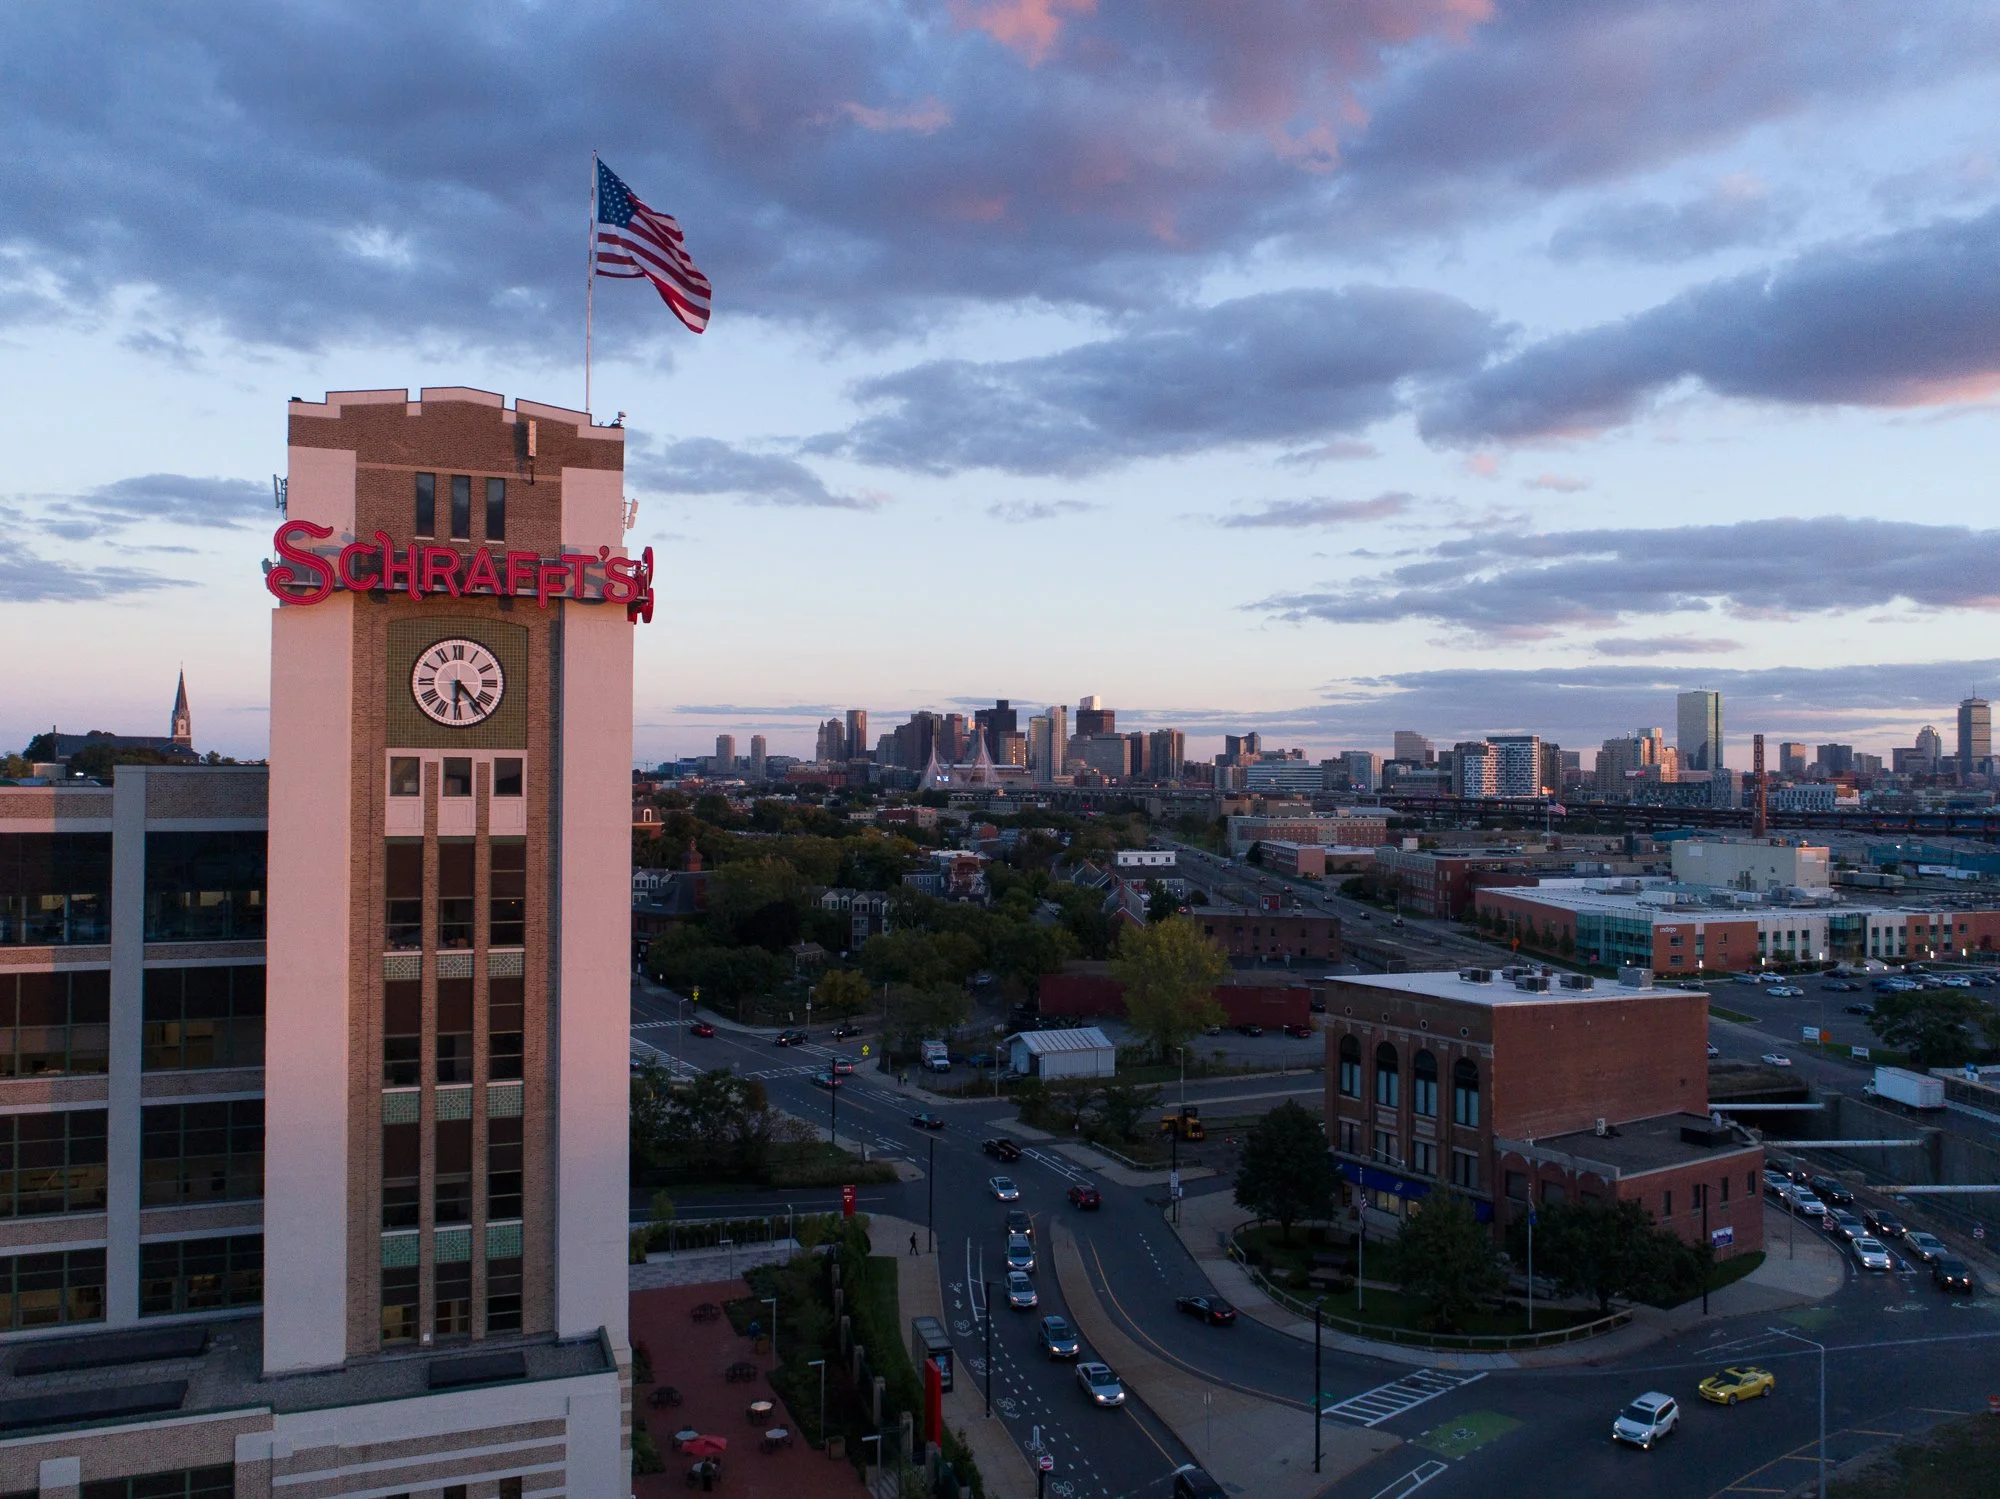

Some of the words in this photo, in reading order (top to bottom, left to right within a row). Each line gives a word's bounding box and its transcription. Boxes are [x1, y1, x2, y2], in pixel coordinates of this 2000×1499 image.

[266, 519, 640, 608] SCHRAFFT'S
[435, 648, 450, 664] XI
[452, 644, 465, 660] XII
[470, 650, 479, 664] I
[423, 661, 439, 673] X
[478, 662, 494, 674] II
[418, 677, 434, 685] IX
[481, 679, 498, 688] III
[420, 688, 440, 706] VIII
[433, 699, 449, 717] VII
